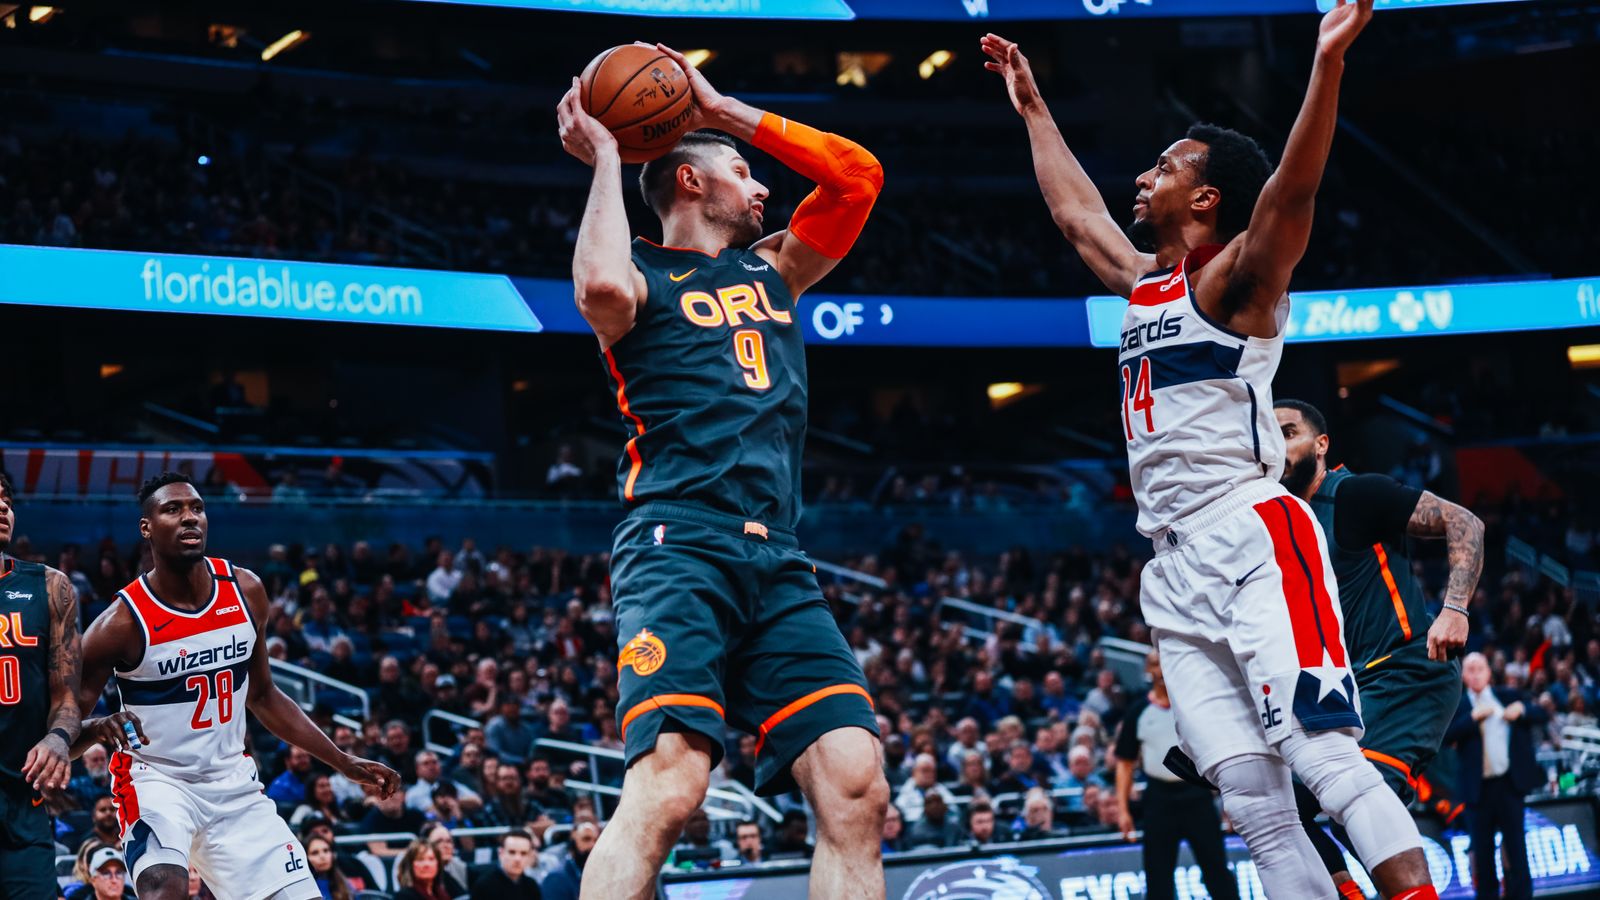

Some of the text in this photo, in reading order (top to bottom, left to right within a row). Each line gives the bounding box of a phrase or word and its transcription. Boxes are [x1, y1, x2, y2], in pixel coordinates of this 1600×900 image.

[642, 102, 695, 143] ALDING
[141, 258, 423, 317] floridablue.com
[680, 281, 793, 328] ORL
[1120, 309, 1185, 354] zards
[1304, 295, 1381, 337] Blue
[733, 328, 771, 391] 9
[1122, 356, 1155, 442] 14
[0, 612, 38, 648] RL
[0, 655, 21, 705] 0
[185, 668, 235, 730] 28
